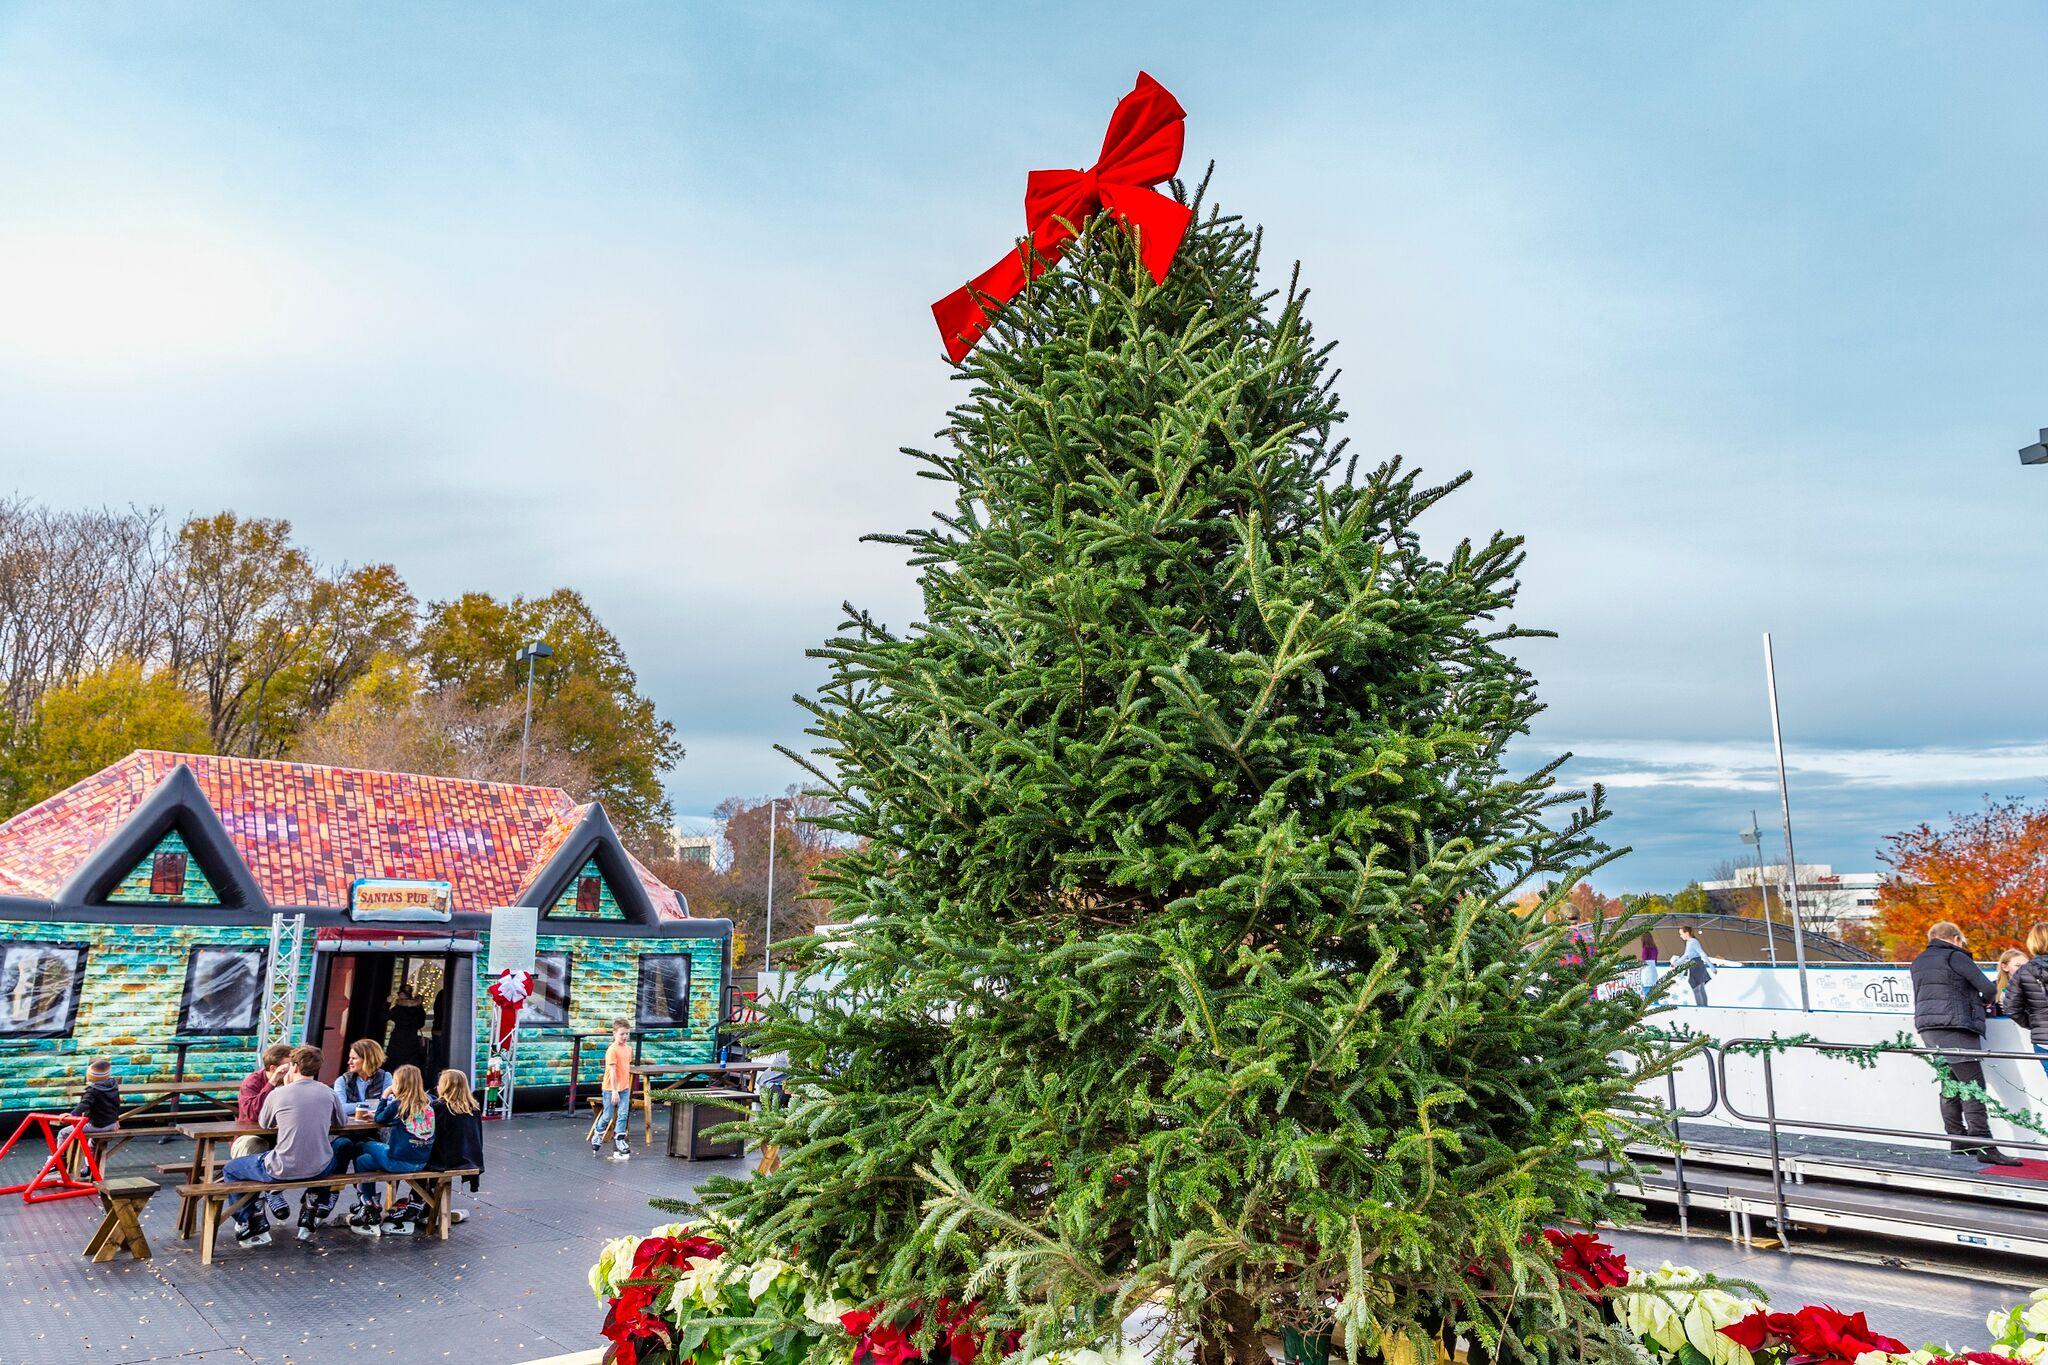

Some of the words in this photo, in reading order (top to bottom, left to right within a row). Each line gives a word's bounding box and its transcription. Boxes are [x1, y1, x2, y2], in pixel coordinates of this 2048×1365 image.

[360, 892, 403, 904] SANTA'S
[406, 892, 428, 904] PUB
[1864, 976, 1910, 1003] Palm
